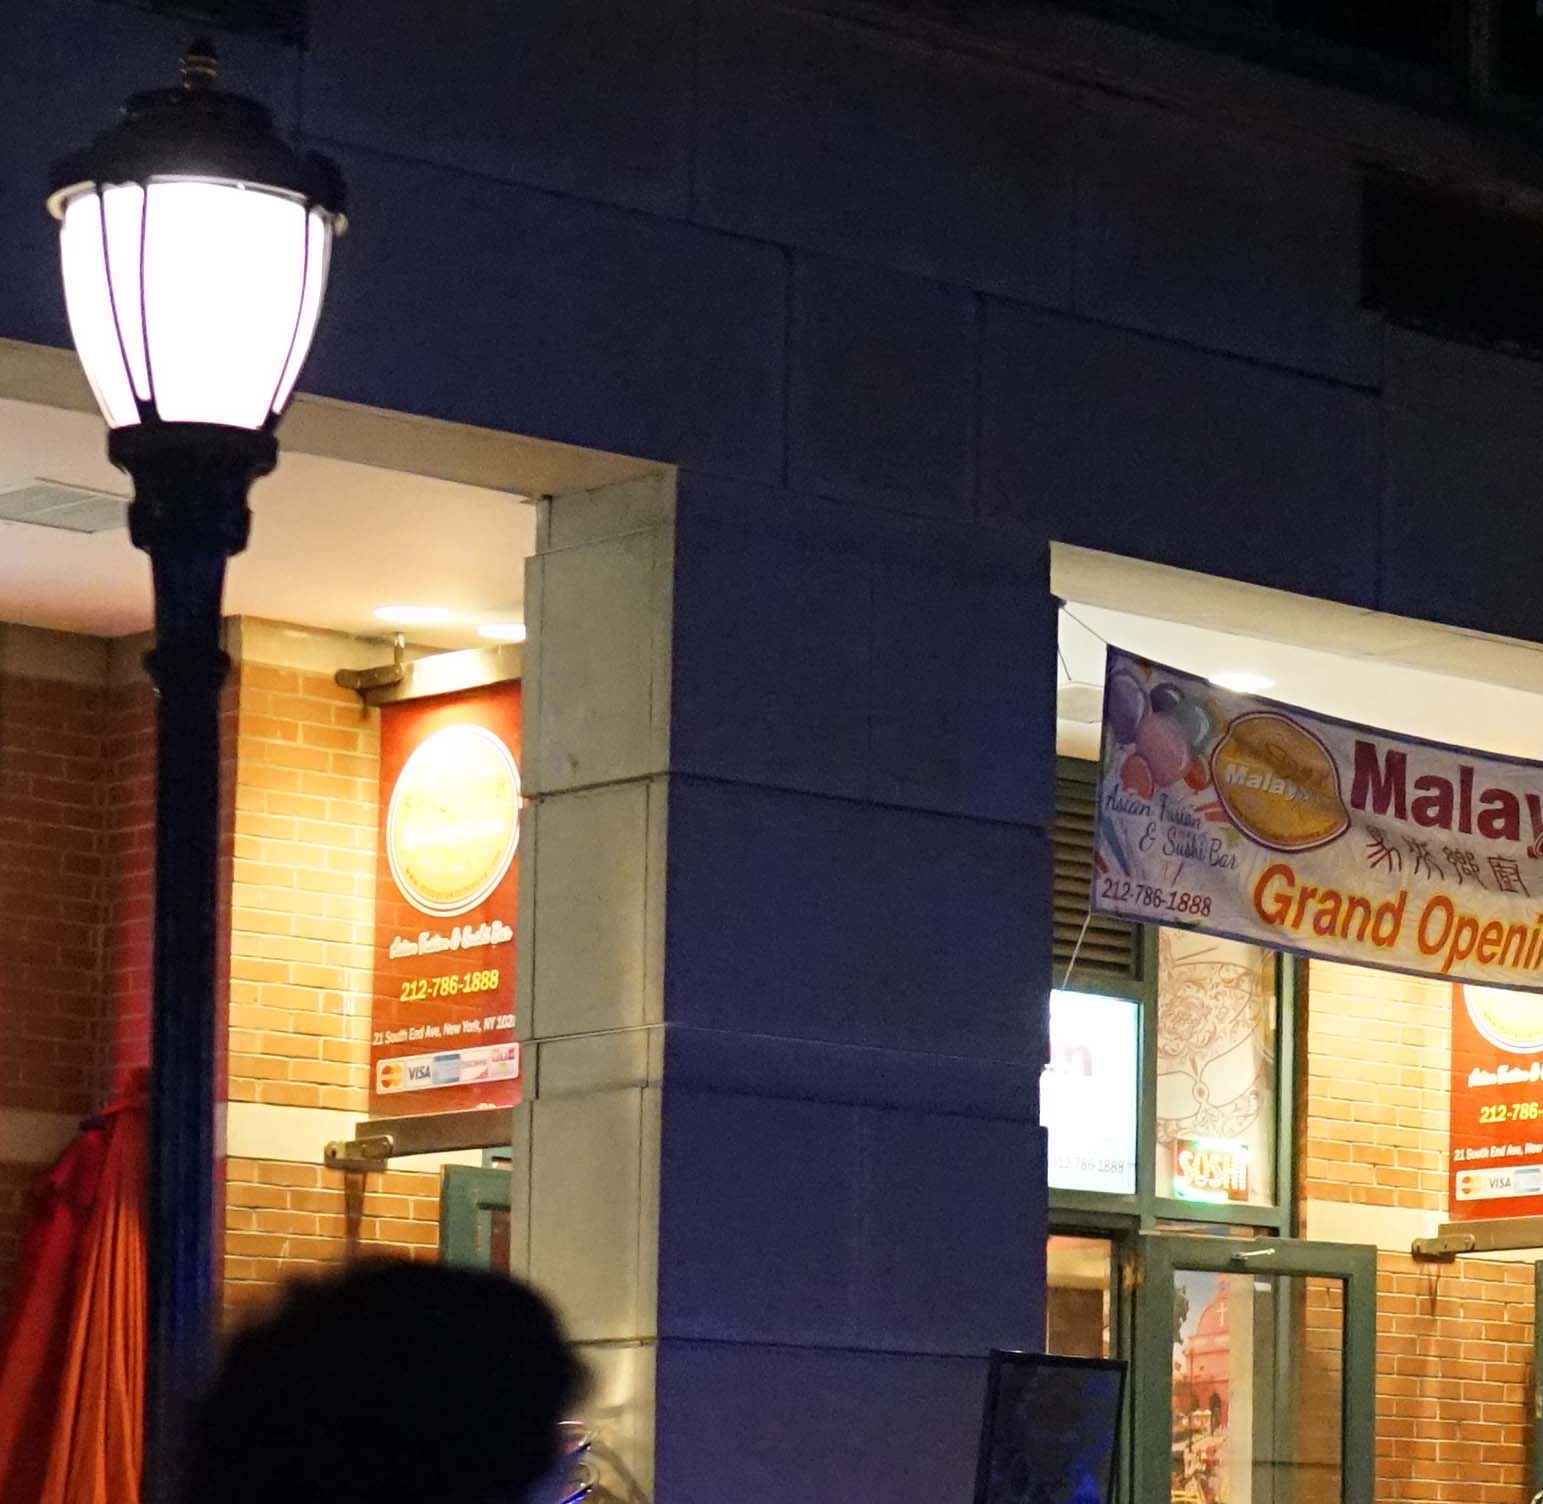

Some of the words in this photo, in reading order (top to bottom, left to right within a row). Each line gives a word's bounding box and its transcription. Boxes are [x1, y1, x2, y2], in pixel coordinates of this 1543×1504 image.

[1208, 838, 1238, 870] Bar
[1102, 878, 1212, 917] 212-786-1888
[1254, 863, 1407, 948] Grand
[400, 969, 499, 1002] 212-786-1888
[444, 1021, 461, 1035] New
[484, 1016, 496, 1031] NY
[408, 1066, 431, 1080] VISA
[1489, 1177, 1511, 1189] VISA
